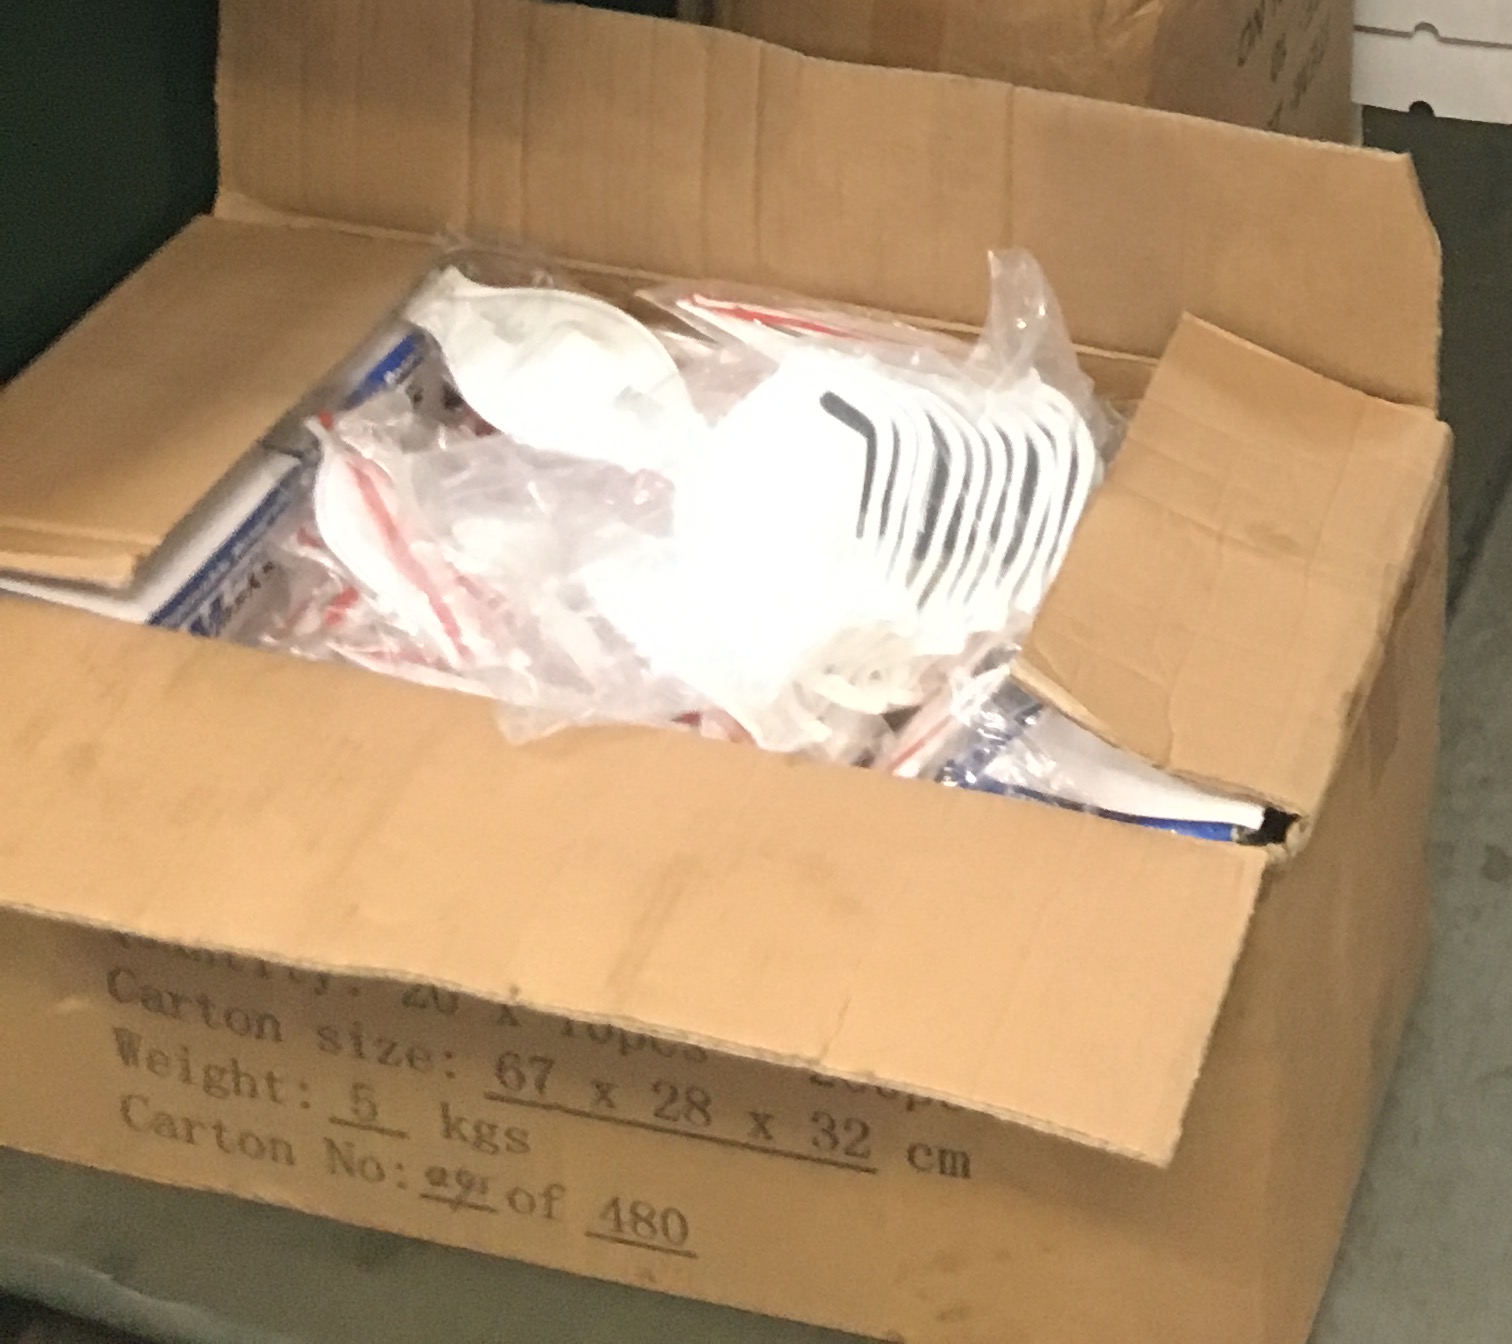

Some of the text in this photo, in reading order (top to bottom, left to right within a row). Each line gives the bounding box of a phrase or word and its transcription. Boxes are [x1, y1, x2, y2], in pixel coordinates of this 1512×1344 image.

[106, 965, 284, 1043] Carton
[315, 1020, 457, 1080] size:
[494, 1049, 555, 1095] 67
[650, 1080, 713, 1127] 28
[810, 1111, 872, 1160] 32
[906, 1140, 972, 1180] cm
[112, 1025, 532, 1156] Weight: 5 kgs
[120, 1092, 296, 1167] Carton
[506, 1181, 567, 1221] of
[599, 1195, 690, 1247] 480
